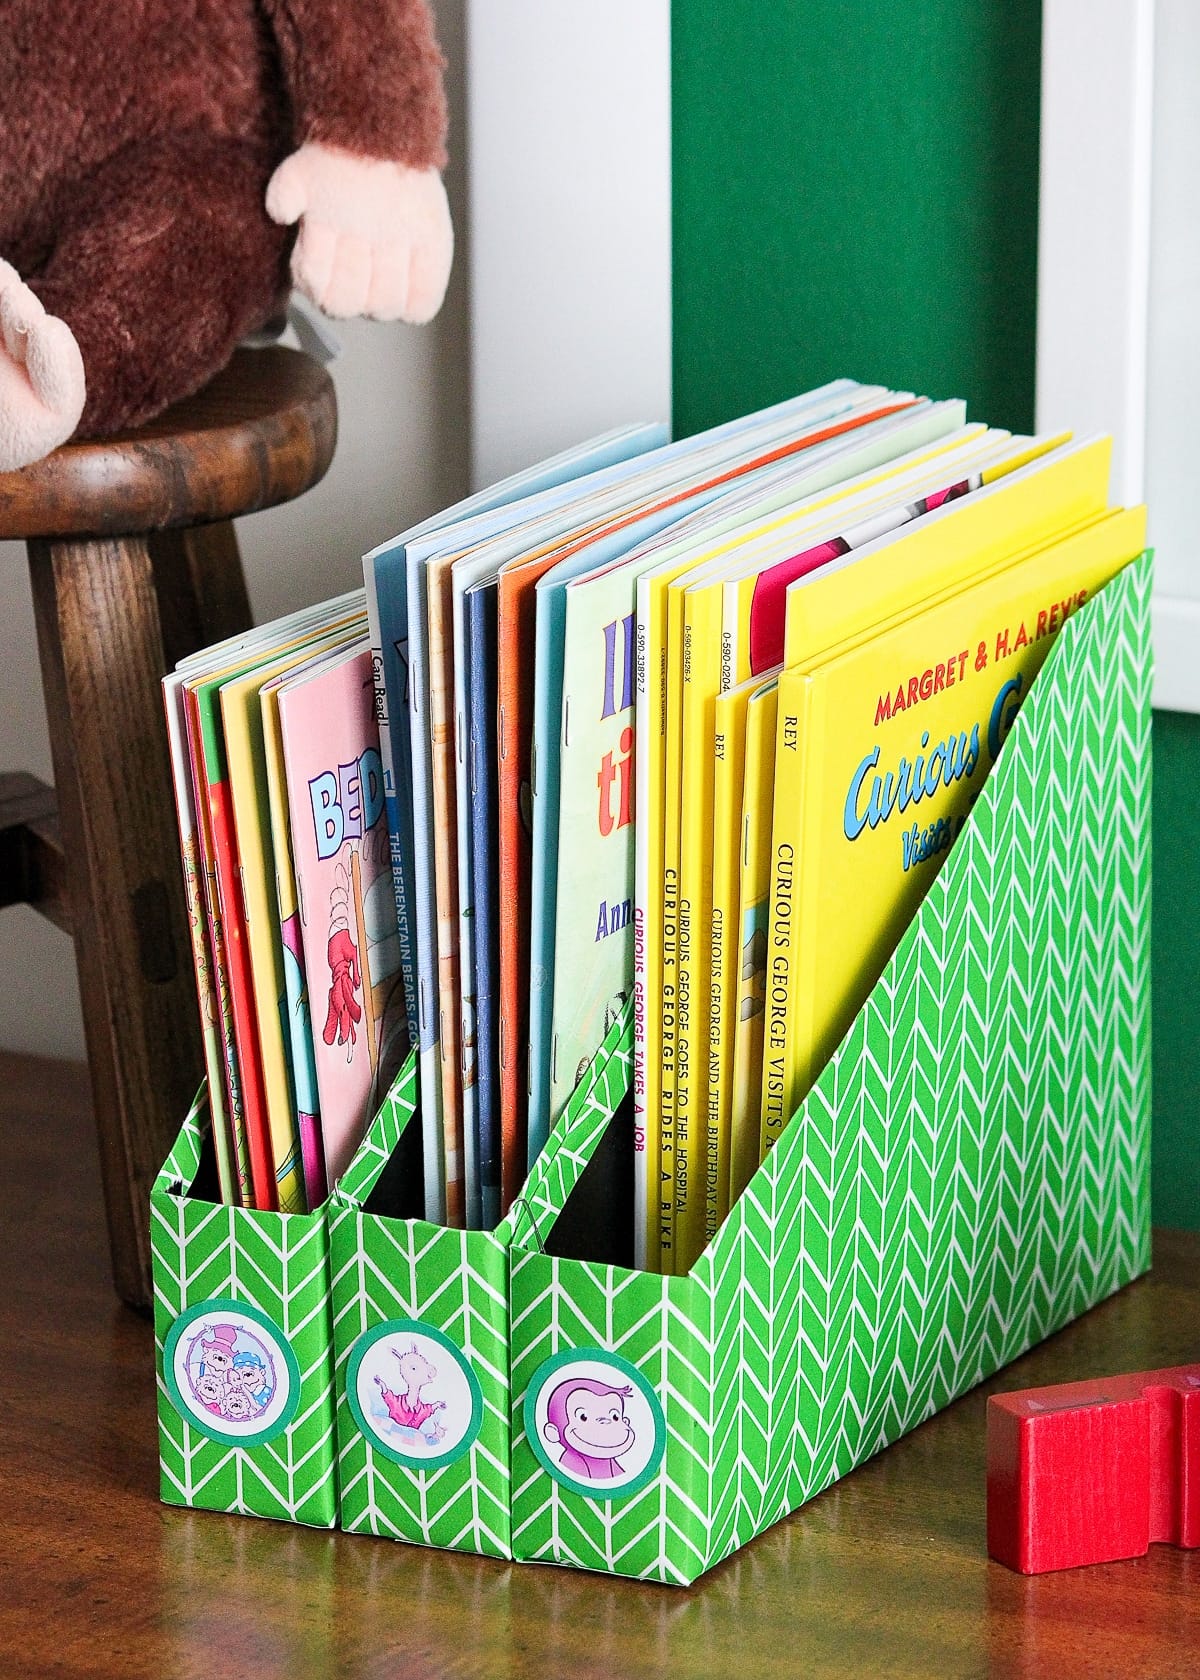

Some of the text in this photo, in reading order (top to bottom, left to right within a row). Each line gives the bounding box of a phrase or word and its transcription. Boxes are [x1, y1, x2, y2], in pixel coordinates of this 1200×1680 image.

[372, 656, 383, 682] Can
[637, 624, 645, 693] 0-590-33892-7
[874, 649, 969, 726] MARGRET
[974, 641, 988, 672] &
[375, 688, 389, 727] Read!
[784, 716, 797, 752] REY
[383, 769, 396, 791] 1
[715, 734, 724, 761] REY
[843, 722, 979, 841] Curious
[389, 832, 419, 1047] THE BERENSTAIN BEARS: GO
[595, 898, 635, 942] Ann
[711, 908, 722, 979] CURIOUS
[634, 908, 644, 1152] CURIOUS GEORGE TAKES A JOB
[710, 983, 722, 1046] GEORGE
[766, 843, 793, 1150] CURIOUS GEORGE VISITS A
[660, 869, 676, 1250] CURIOUS GEORGE RIDES A BIKE
[676, 899, 690, 1214] CURIOUS GEORGE GOES TO THE HOSPITAL
[708, 1052, 720, 1083] AND
[707, 1087, 719, 1121] THE
[706, 1126, 719, 1204] BIRTHDAY
